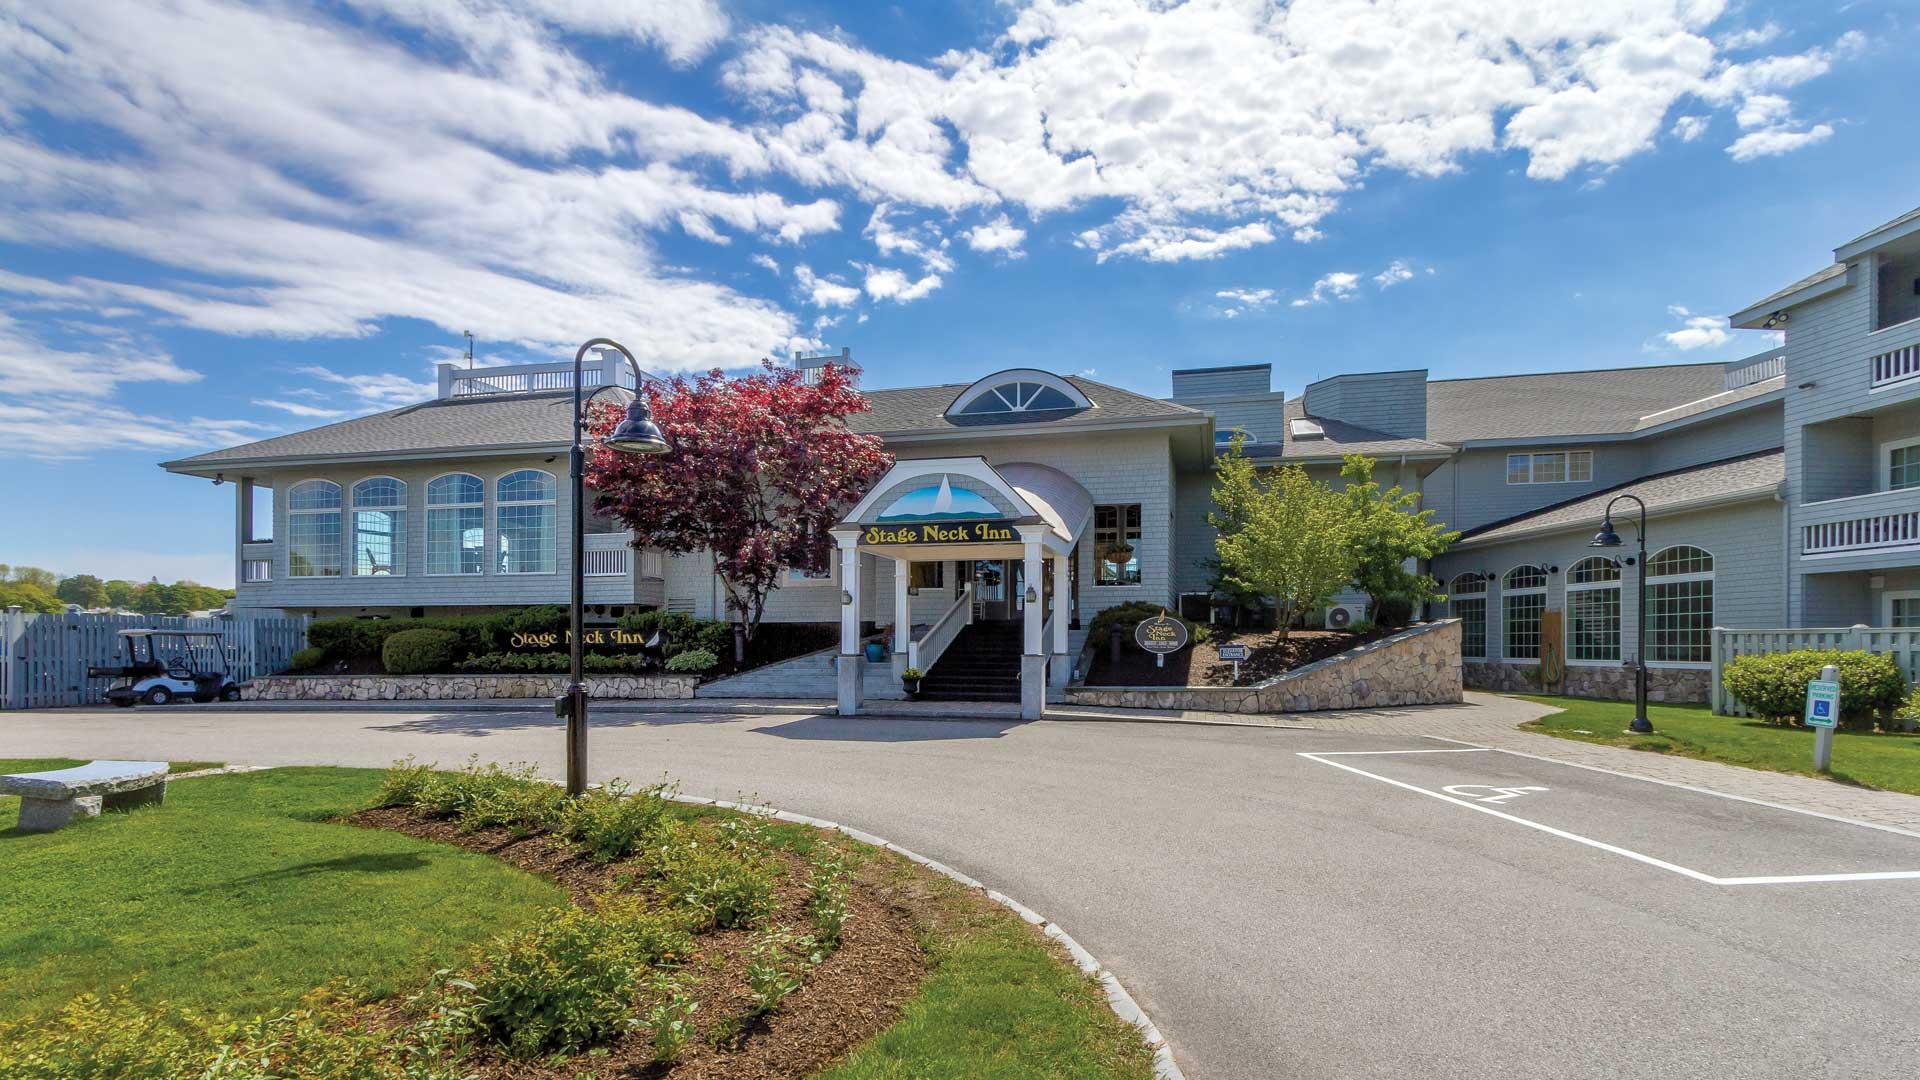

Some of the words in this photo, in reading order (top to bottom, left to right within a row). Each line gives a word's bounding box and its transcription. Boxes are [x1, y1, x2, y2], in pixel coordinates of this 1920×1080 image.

[866, 527, 917, 544] Stage
[922, 525, 970, 542] Neck
[975, 523, 1012, 540] Inn
[510, 631, 558, 648] Stage
[610, 629, 645, 644] Inn
[1146, 625, 1173, 633] Stage
